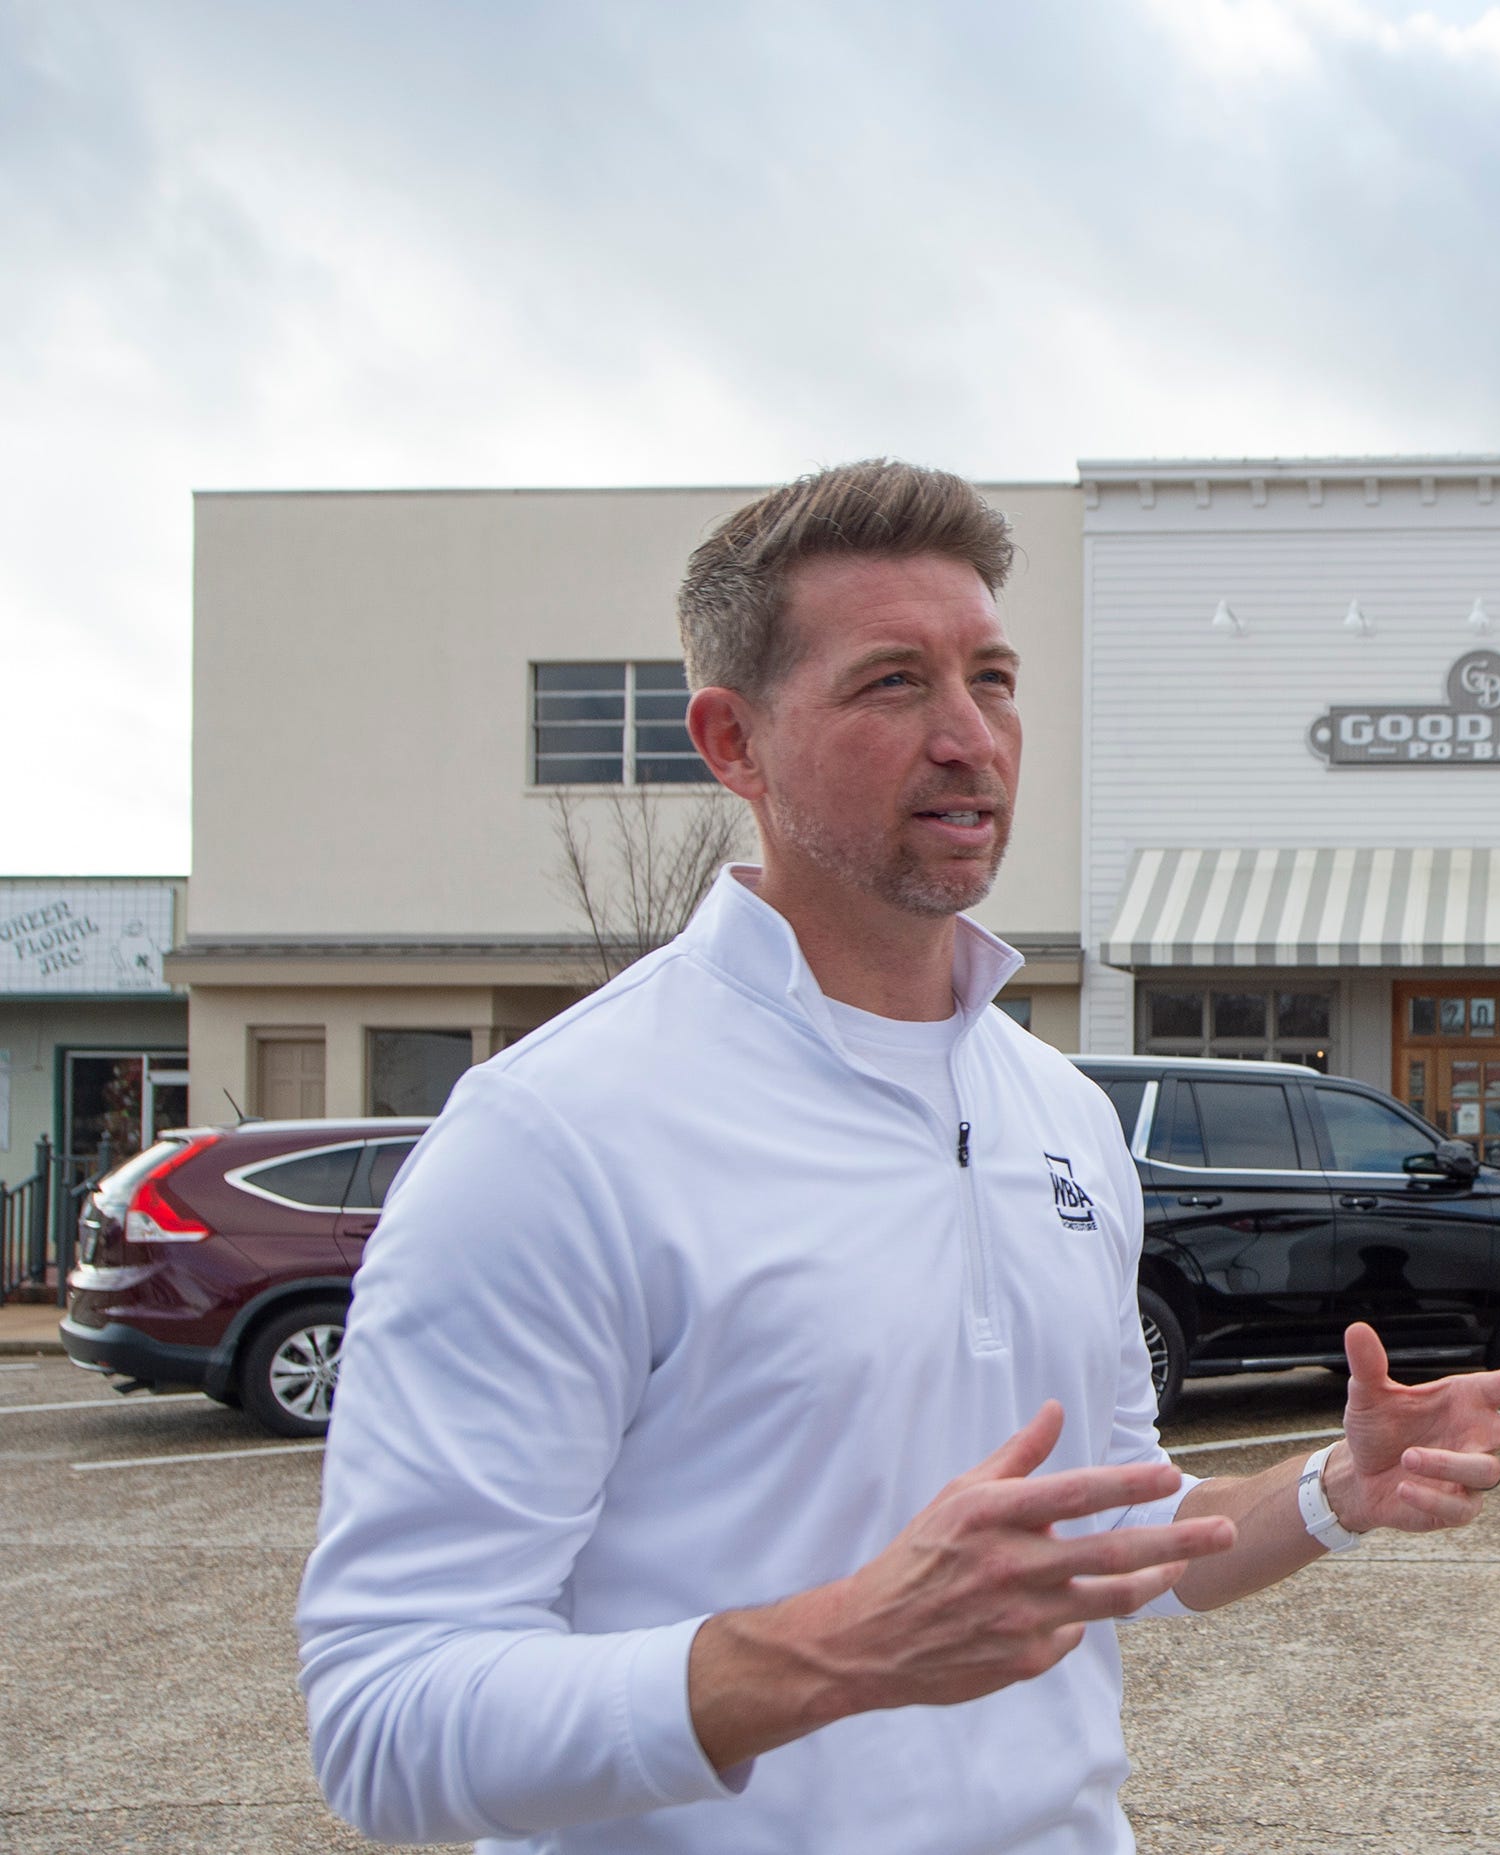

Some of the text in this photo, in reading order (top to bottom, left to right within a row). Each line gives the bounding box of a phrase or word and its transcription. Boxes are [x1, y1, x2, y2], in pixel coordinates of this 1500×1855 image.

[1340, 714, 1492, 746] GOOD
[14, 914, 99, 961] FLORAL
[1049, 1172, 1095, 1209] WBA
